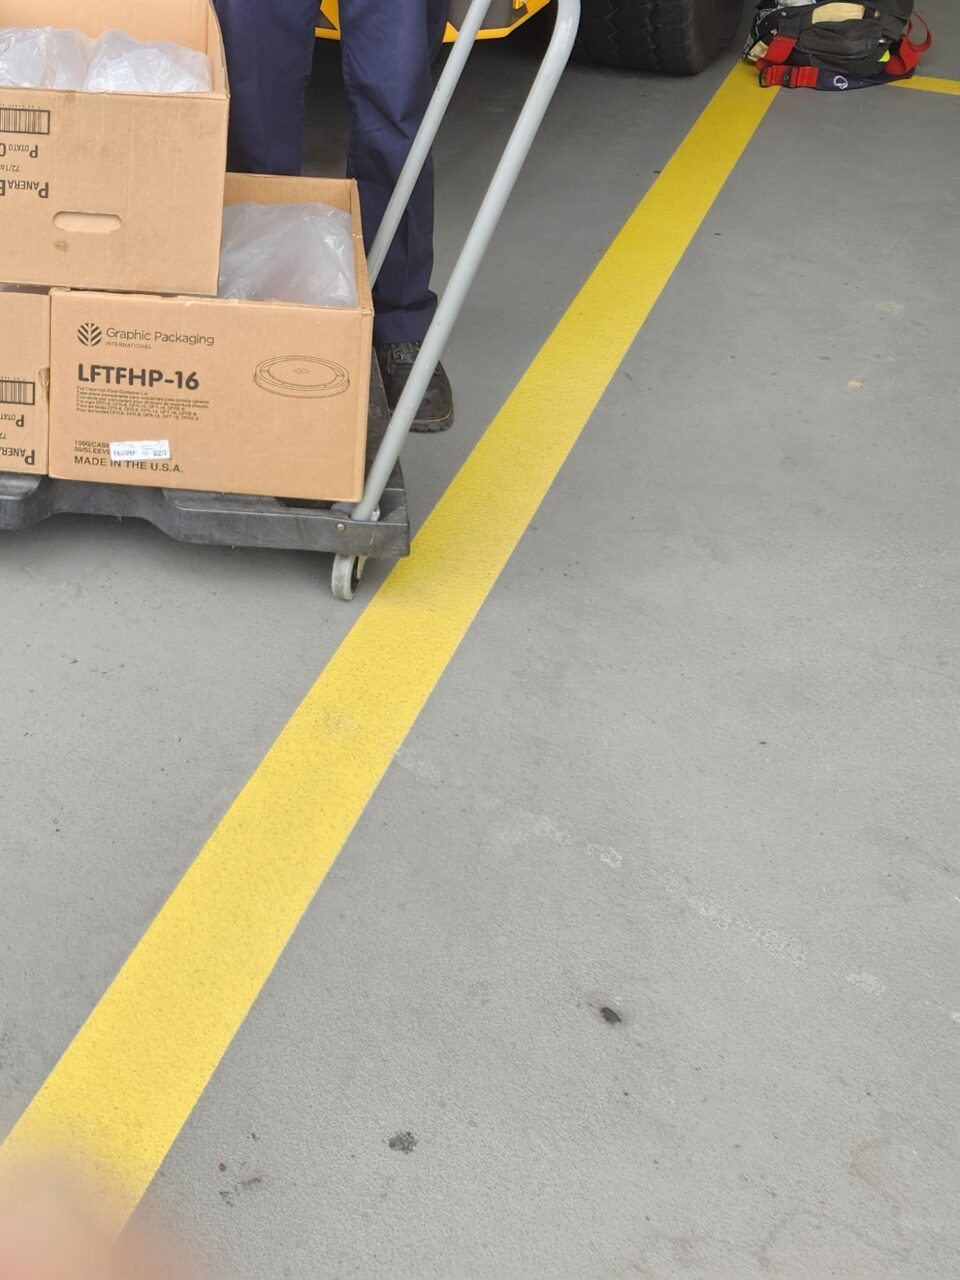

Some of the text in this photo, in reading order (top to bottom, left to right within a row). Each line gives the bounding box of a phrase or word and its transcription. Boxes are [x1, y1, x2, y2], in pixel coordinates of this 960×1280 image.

[8, 179, 49, 199] PANERA
[106, 327, 215, 347] Graphic Packaging
[106, 341, 152, 349] INTERNATIONAL
[78, 363, 200, 390] LFTFHP-16
[74, 456, 107, 466] MADE
[123, 460, 147, 470] THE
[150, 462, 184, 473] U.S.A.
